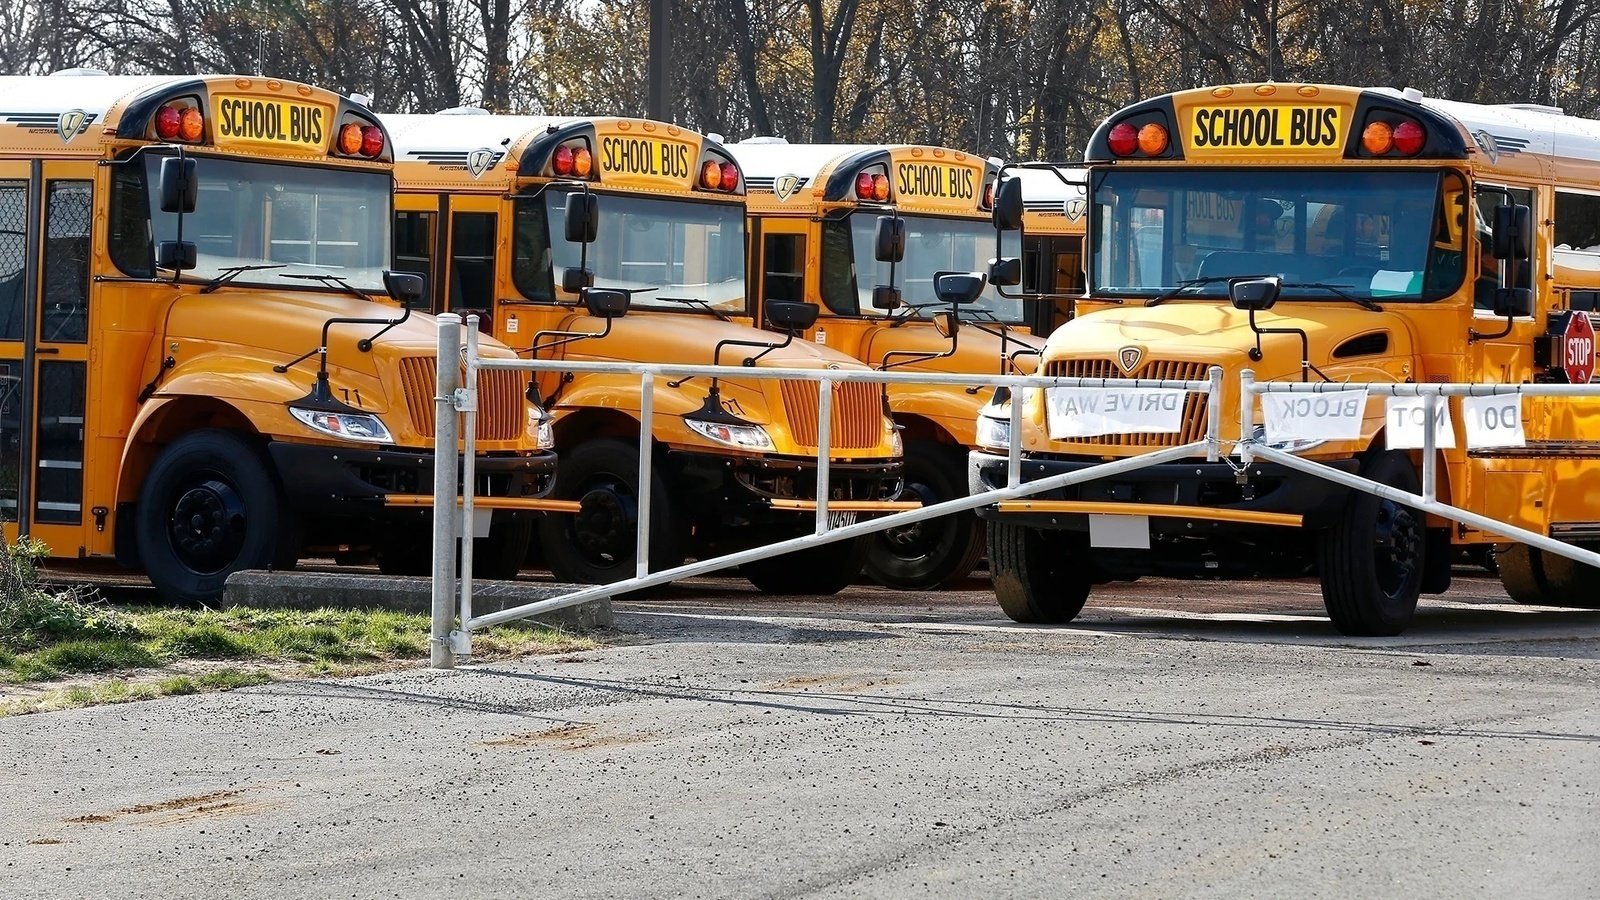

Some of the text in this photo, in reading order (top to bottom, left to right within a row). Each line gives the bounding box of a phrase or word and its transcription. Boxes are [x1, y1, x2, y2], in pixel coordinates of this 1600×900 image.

[221, 98, 322, 144] SCHOOL BUS
[1194, 107, 1337, 147] SCHOOL BUS
[603, 137, 688, 178] SCHOOL BUS
[899, 163, 973, 200] SCHOOL BUS
[1568, 337, 1591, 366] STOP
[338, 387, 362, 407] 71
